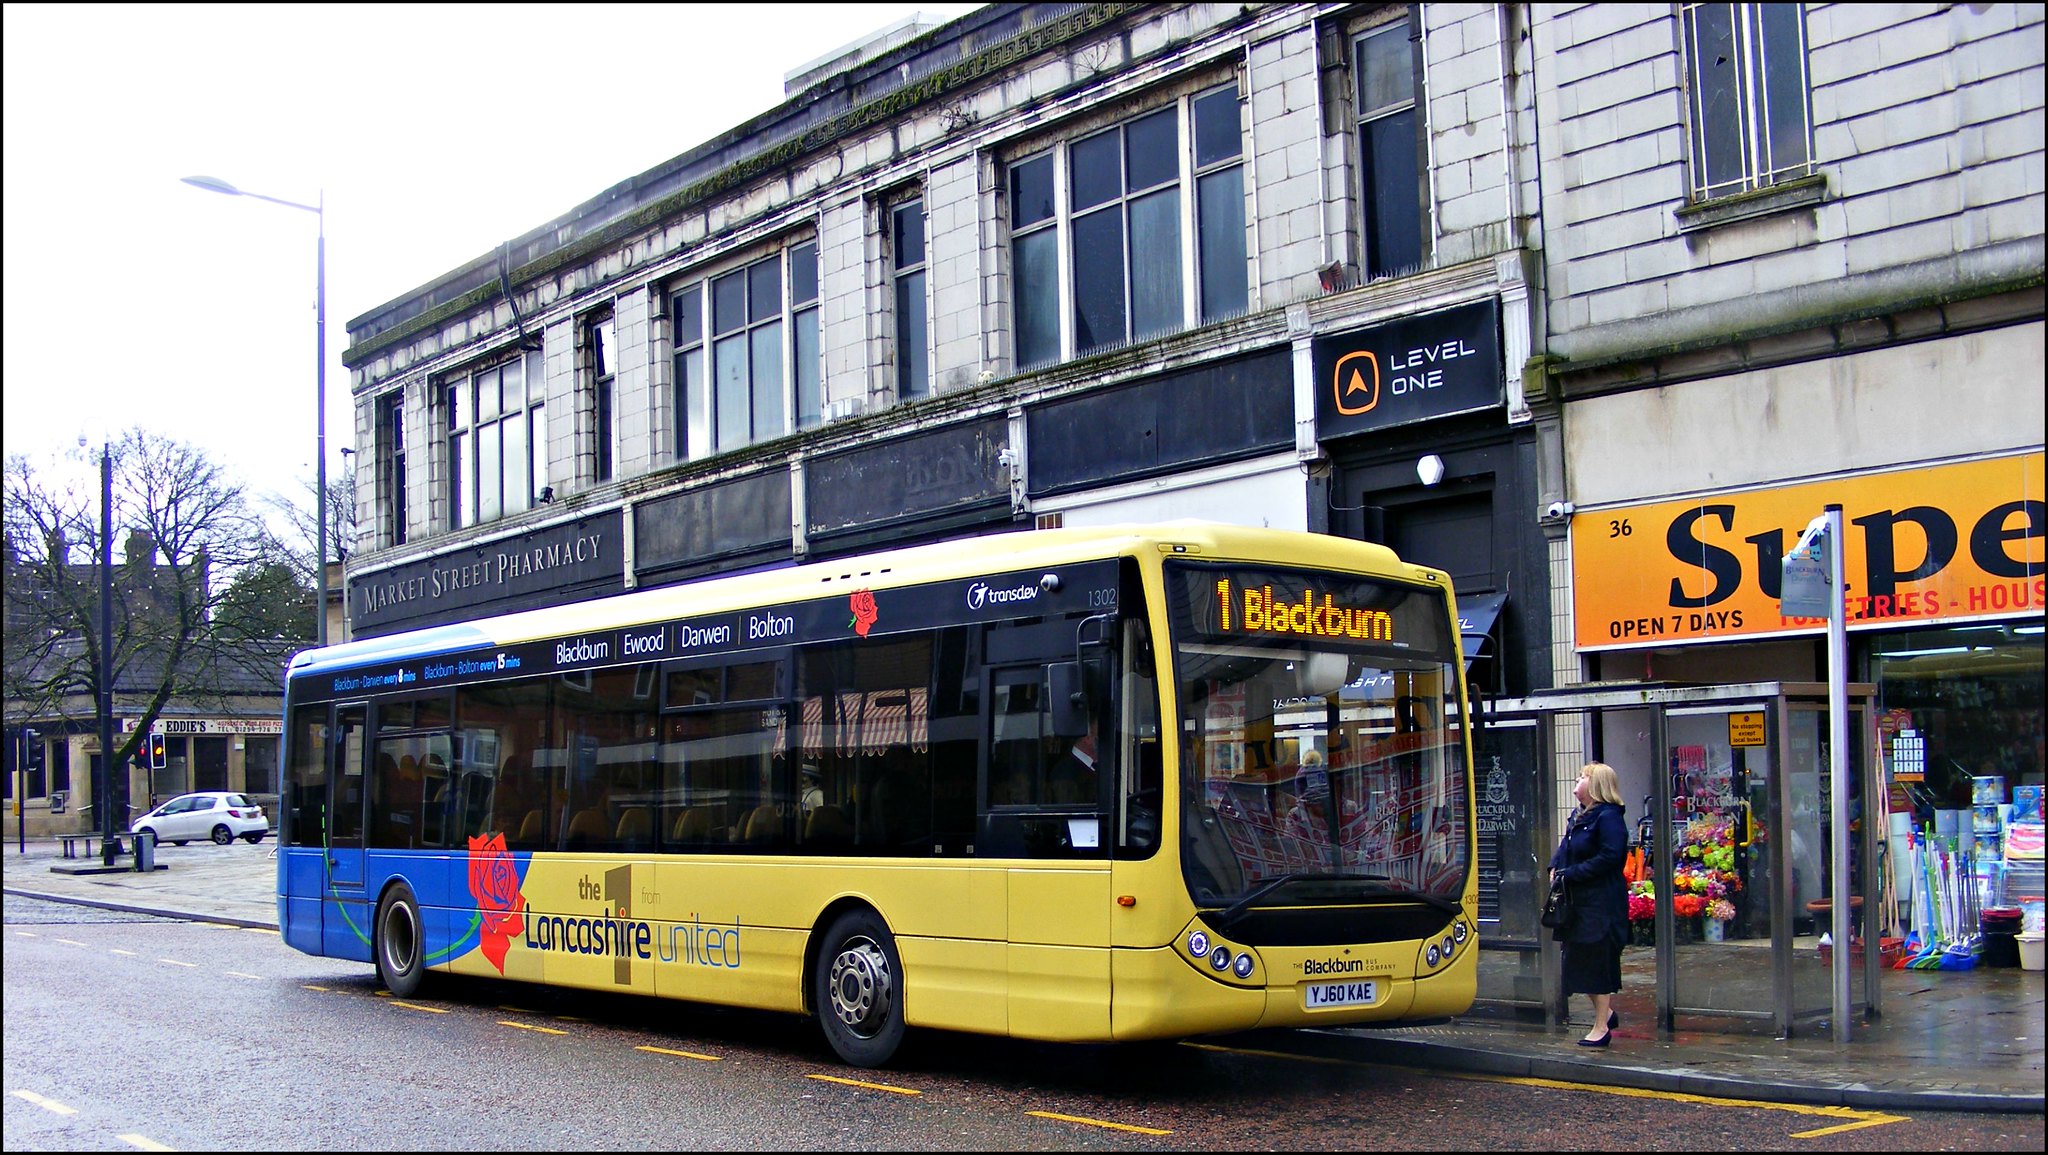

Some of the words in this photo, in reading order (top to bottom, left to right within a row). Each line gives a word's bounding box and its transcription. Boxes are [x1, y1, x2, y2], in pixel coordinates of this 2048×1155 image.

[1391, 339, 1476, 371] LEVEL
[1391, 370, 1443, 395] ONE
[1609, 518, 1632, 538] 36
[364, 576, 426, 614] MARKET
[432, 560, 492, 598] STREET
[497, 534, 602, 584] PHARMACY
[987, 584, 1039, 604] transdev
[1088, 588, 1116, 607] 1302
[1217, 578, 1231, 630] 1
[1243, 585, 1393, 641] Blackburn
[1610, 616, 1664, 639] OPEN
[1671, 615, 1682, 633] 7
[1690, 610, 1743, 632] DAYS
[556, 638, 609, 664] Blackburn
[624, 626, 665, 655] Ewood
[681, 624, 730, 648] Darwen
[749, 611, 794, 640] Bolton
[424, 665, 454, 680] Blackburn
[458, 660, 480, 674] Bolton
[480, 661, 497, 672] every
[497, 653, 506, 670] 15
[506, 656, 521, 668] mins
[334, 678, 360, 692] Blackburn
[363, 675, 384, 689] Darwen
[384, 675, 398, 686] every
[398, 669, 404, 683] 8
[403, 672, 416, 682] mins
[166, 720, 206, 732] EDDIE'S
[1478, 818, 1516, 831] DARWEN
[524, 902, 651, 960] Lancashire
[657, 912, 741, 969] united
[578, 874, 601, 901] the
[604, 863, 632, 986] 1
[641, 887, 661, 905] from
[1304, 957, 1363, 975] Blackburn
[1312, 985, 1345, 1003] YJ60
[1348, 983, 1372, 1001] KAE
